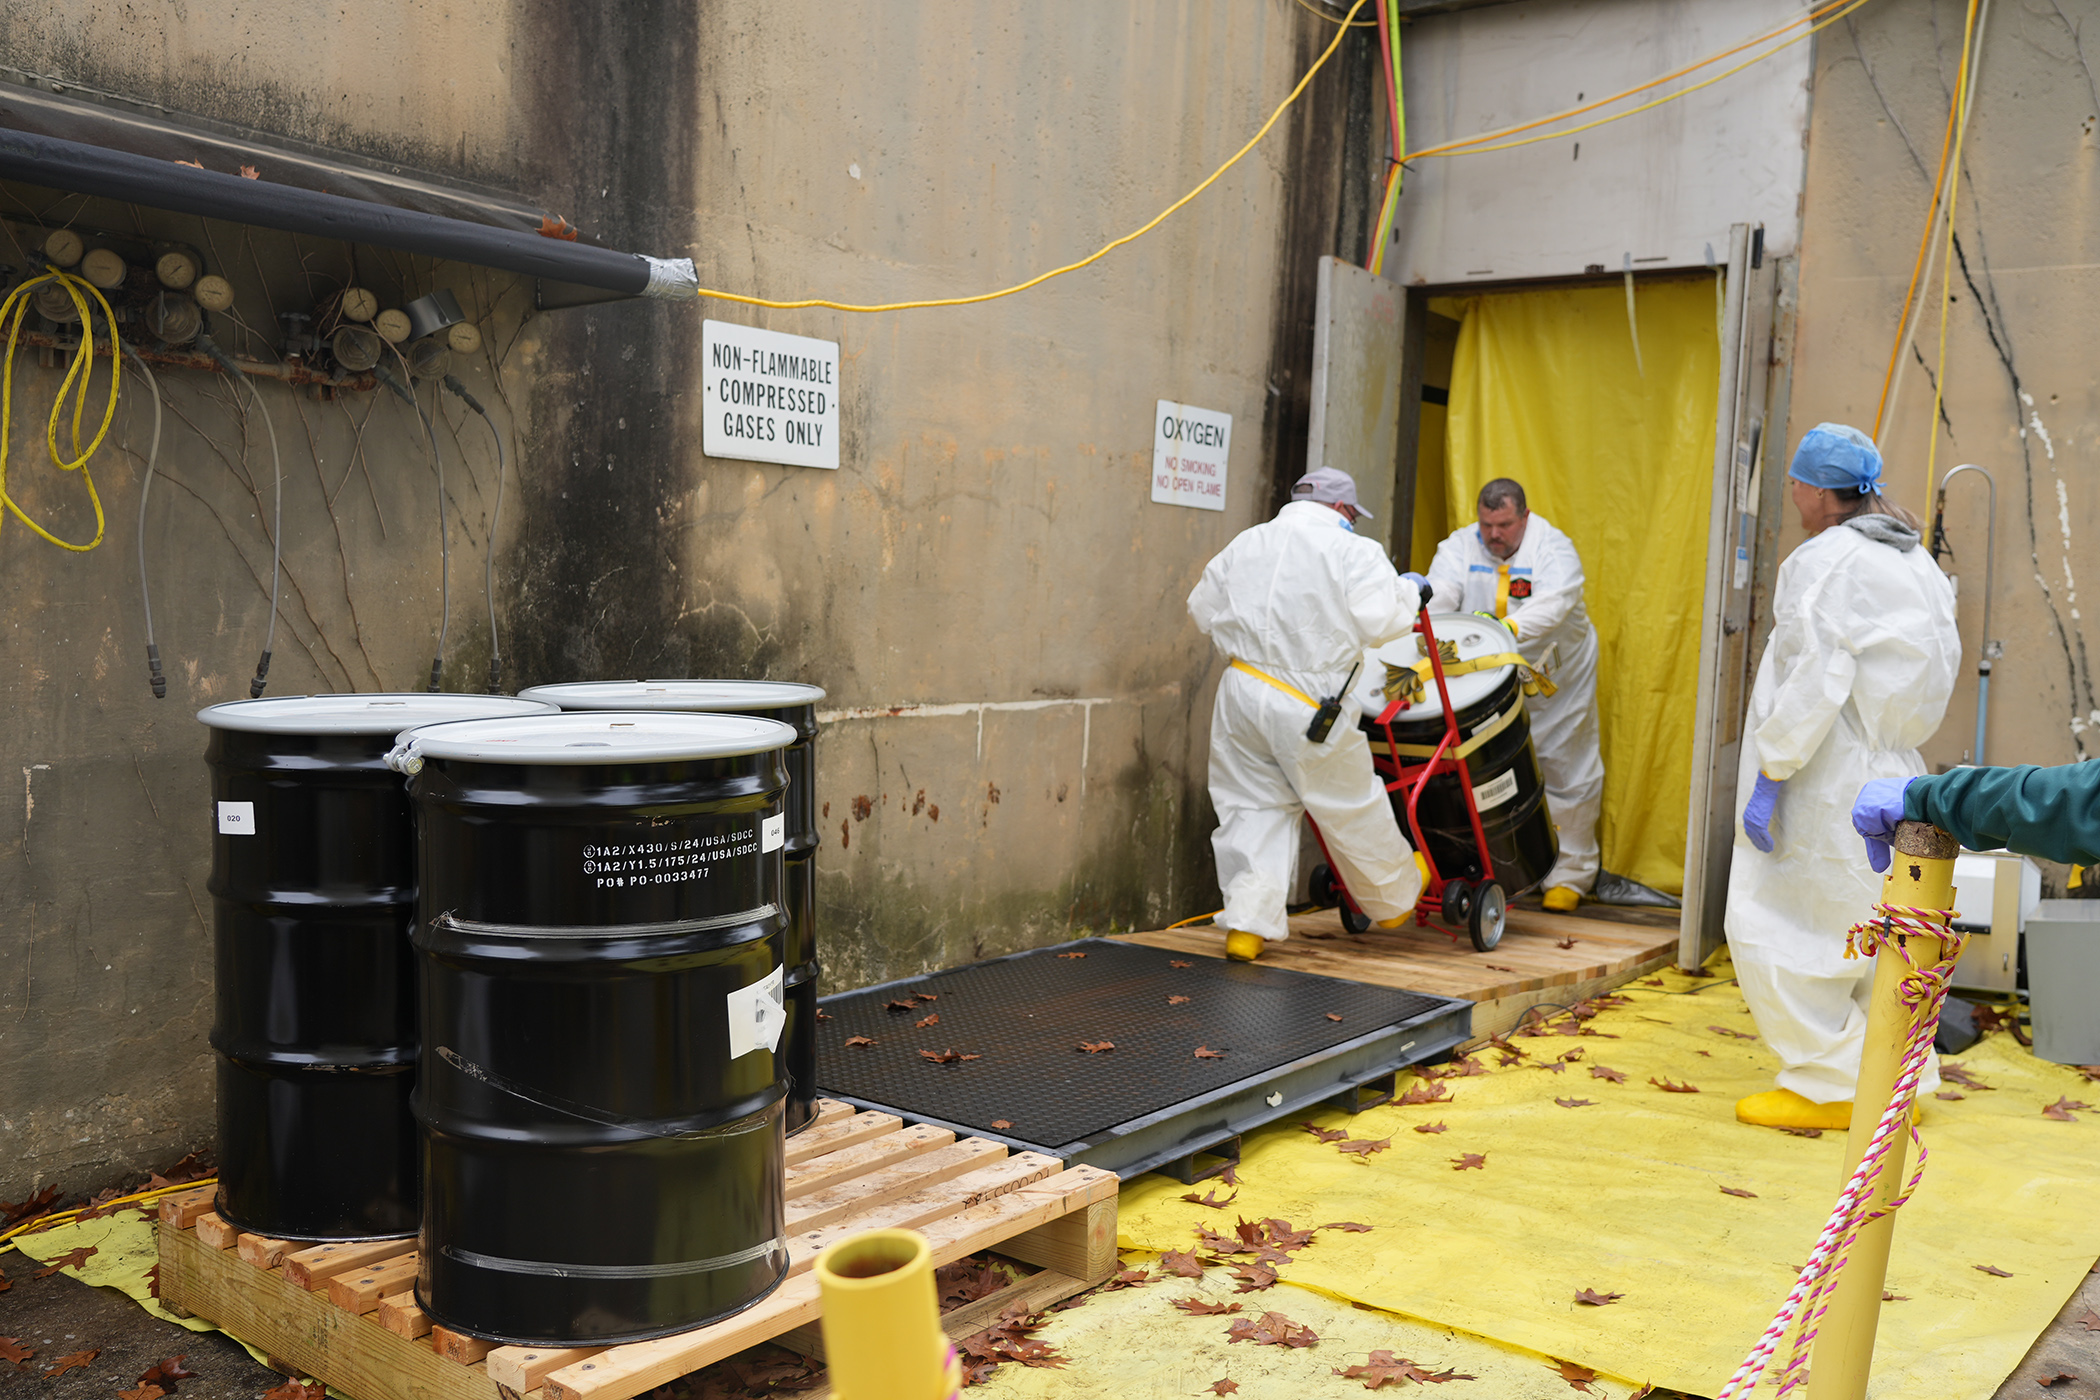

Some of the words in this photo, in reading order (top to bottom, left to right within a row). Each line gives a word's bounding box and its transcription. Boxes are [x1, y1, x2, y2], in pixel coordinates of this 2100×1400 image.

[713, 343, 832, 385] NON-FLAMMABLE
[720, 378, 826, 415] COMPRESSED
[723, 412, 775, 441] GASES
[785, 420, 823, 447] ONLY
[1162, 416, 1225, 448] OXYGEN
[1165, 456, 1178, 471] NO
[1181, 458, 1216, 477] SMOKING
[1156, 475, 1169, 489] NO
[1172, 476, 1194, 492] OPEN
[1196, 481, 1222, 497] FLAME
[597, 877, 624, 888] PO#
[630, 868, 709, 887] PO-0033477
